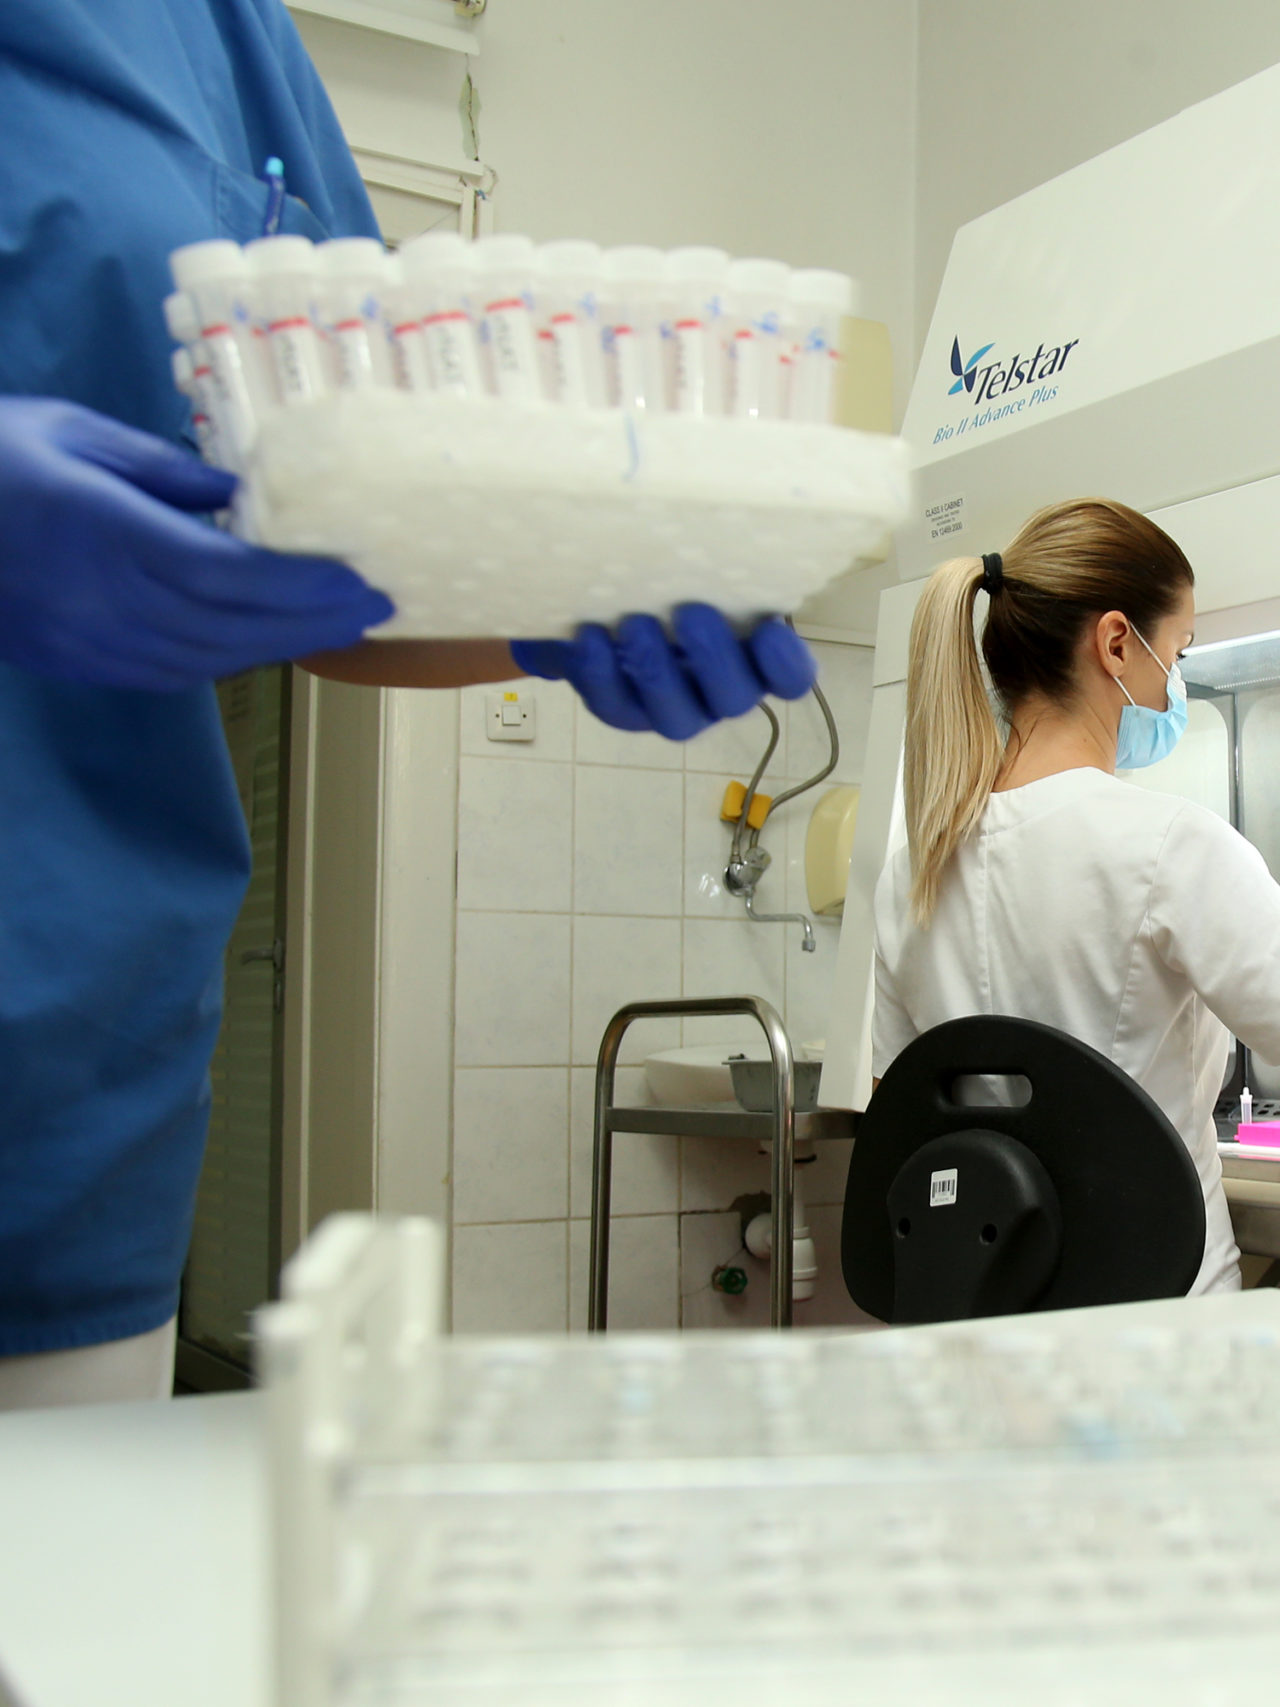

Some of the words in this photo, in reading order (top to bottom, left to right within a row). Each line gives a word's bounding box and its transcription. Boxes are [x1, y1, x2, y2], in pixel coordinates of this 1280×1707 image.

[974, 338, 1080, 406] Telstar
[932, 424, 954, 445] Bio
[969, 398, 1026, 431] Advance
[1028, 385, 1059, 408] Plus
